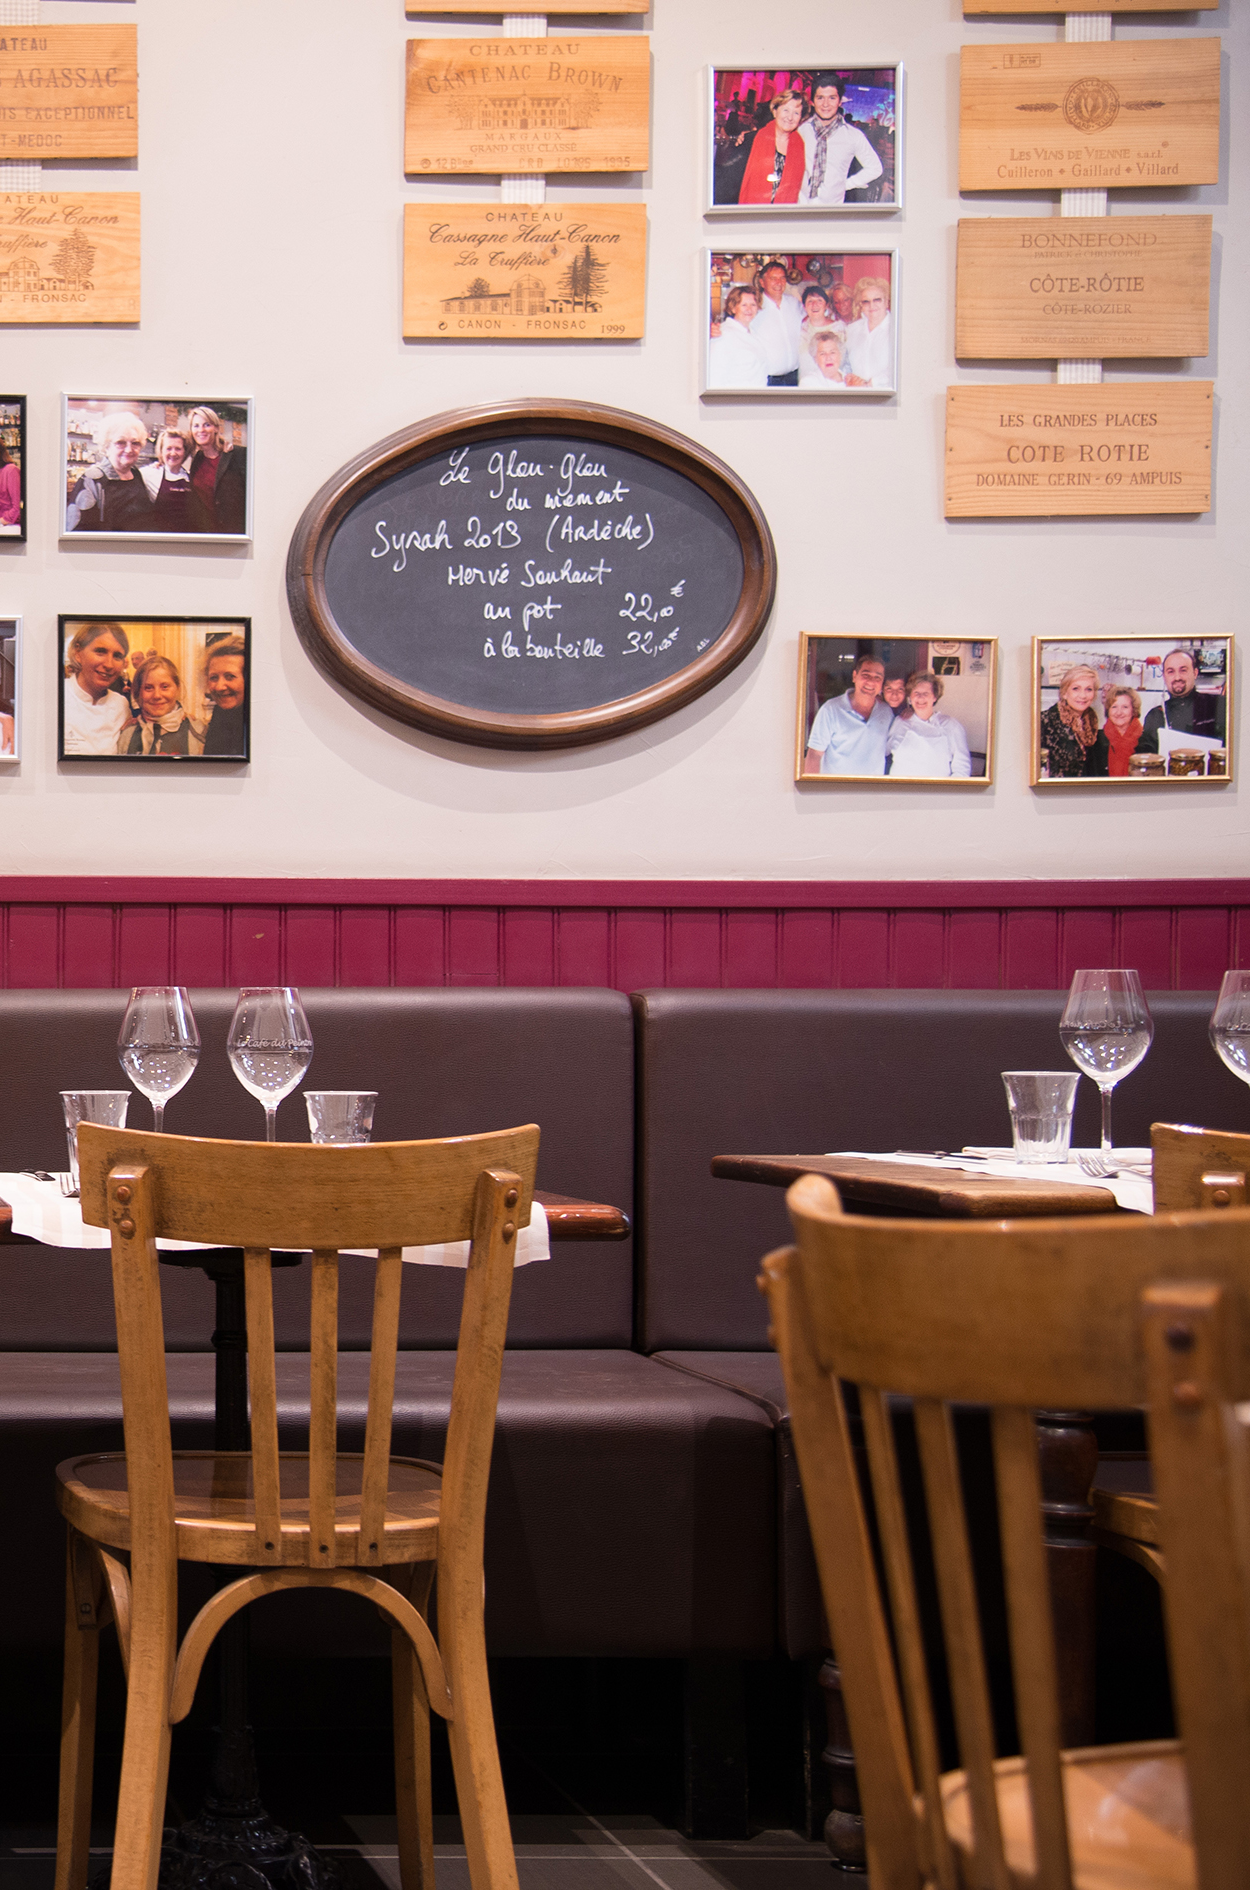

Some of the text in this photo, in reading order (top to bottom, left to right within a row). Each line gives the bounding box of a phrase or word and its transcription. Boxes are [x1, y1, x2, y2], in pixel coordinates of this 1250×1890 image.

[469, 44, 580, 56] CHATEAU
[13, 67, 118, 89] AGASSAC
[548, 62, 624, 92] BROWN
[25, 106, 135, 120] EXCEPTIONNEL
[485, 133, 562, 141] MARGAUX
[470, 144, 508, 153] GRAND
[512, 144, 535, 153] CRU
[1010, 148, 1031, 161] LES
[1033, 147, 1064, 161] VINS
[1084, 146, 1130, 160] VIENNE
[997, 162, 1179, 179] Cuilleron Gaillard Villard
[8, 205, 119, 226] Haut-Canon
[486, 212, 563, 222] CHATEAU
[429, 223, 621, 247] Cassagne Haut-Canon
[1021, 233, 1157, 249] BONNEFOND
[454, 251, 550, 270] La Truffière
[1030, 273, 1144, 293] CÔTE-RÔTIE
[23, 293, 87, 304] FRONSAC
[458, 320, 501, 330] CANON
[527, 320, 586, 330] FRONSAC
[601, 324, 625, 334] 1999
[1000, 413, 1157, 427] LES GRANDES PLACES
[1007, 444, 1150, 464] COTE ROTIE
[439, 447, 471, 486] Le
[976, 474, 1038, 487] DOMAINE
[1048, 473, 1091, 485] GERIN
[1105, 473, 1122, 485] 69
[1130, 472, 1182, 485] AMPUIS
[506, 488, 531, 511] du
[371, 519, 453, 572] Syrah
[463, 516, 521, 549] 2013
[448, 563, 509, 586] Hervé
[483, 602, 512, 619] au
[522, 596, 562, 631] pot
[483, 638, 496, 657] à
[526, 633, 606, 659] bouteille
